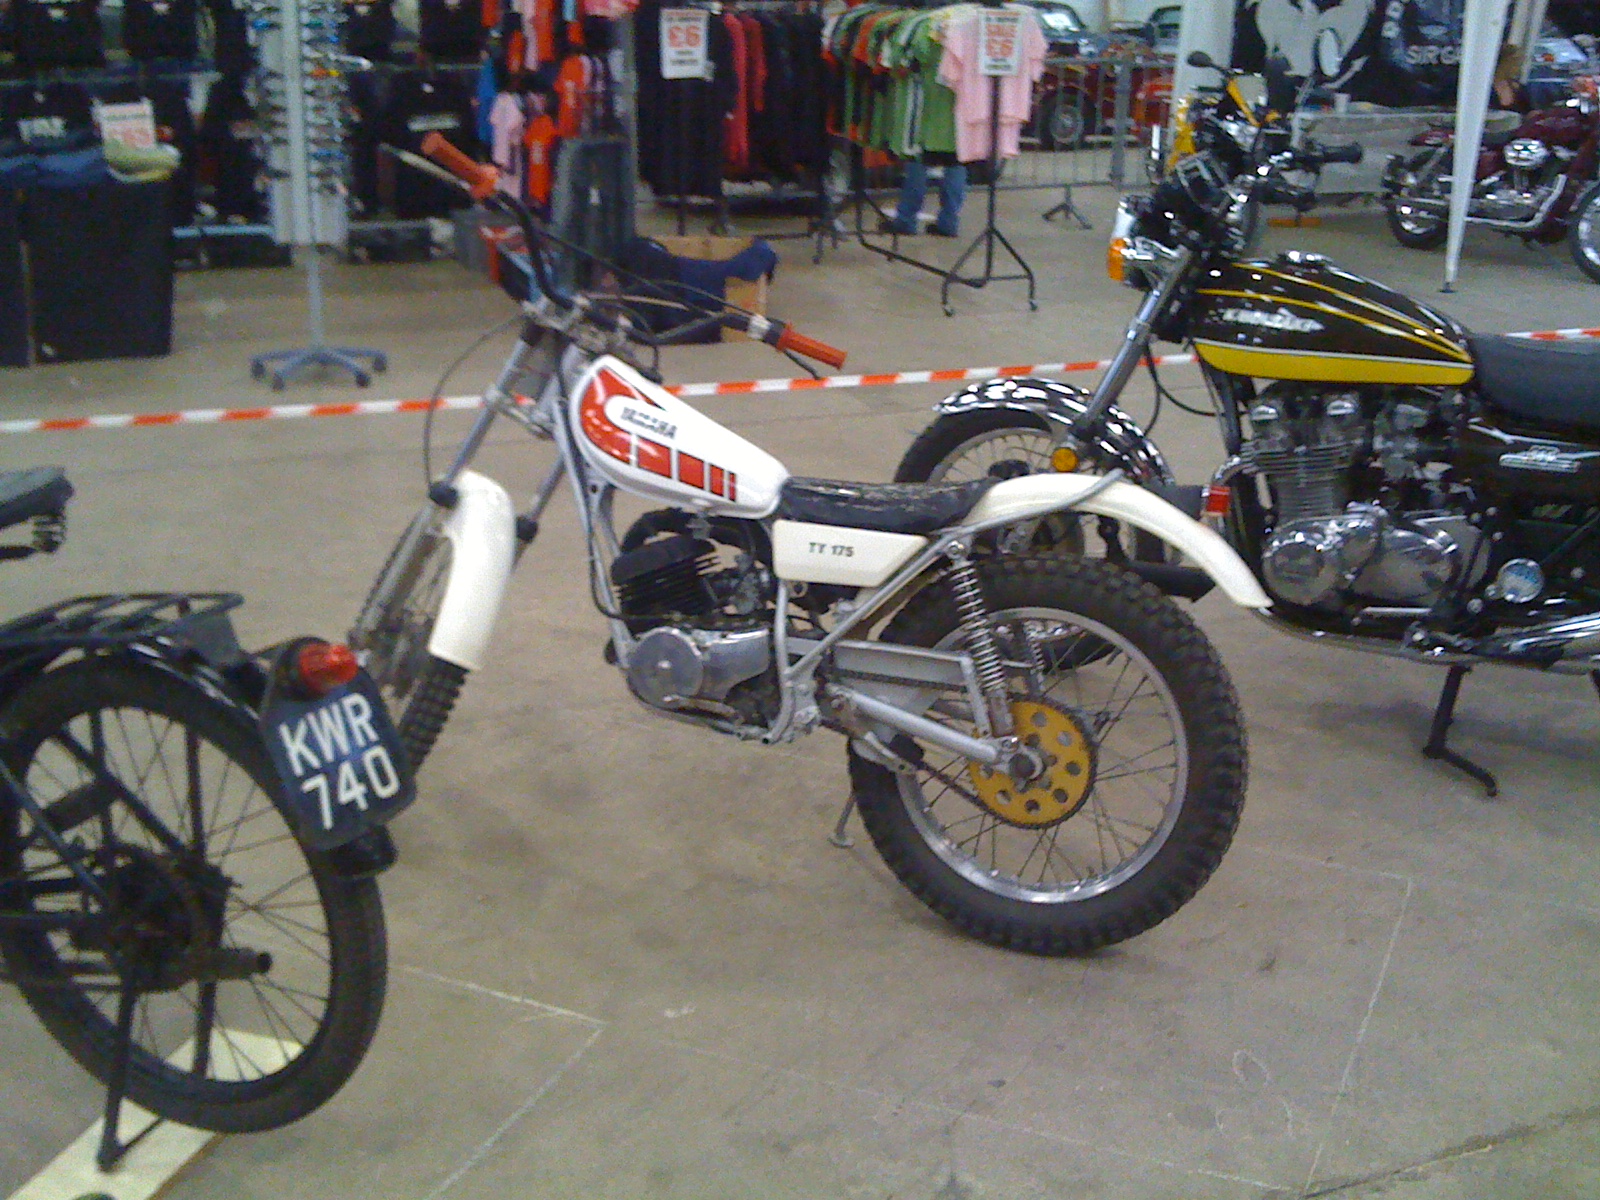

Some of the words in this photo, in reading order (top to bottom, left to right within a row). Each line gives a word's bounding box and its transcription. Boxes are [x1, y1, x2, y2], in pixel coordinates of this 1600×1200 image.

[808, 541, 826, 553] TY
[831, 545, 855, 557] 175
[279, 692, 380, 777] KWR
[301, 745, 400, 830] 740
